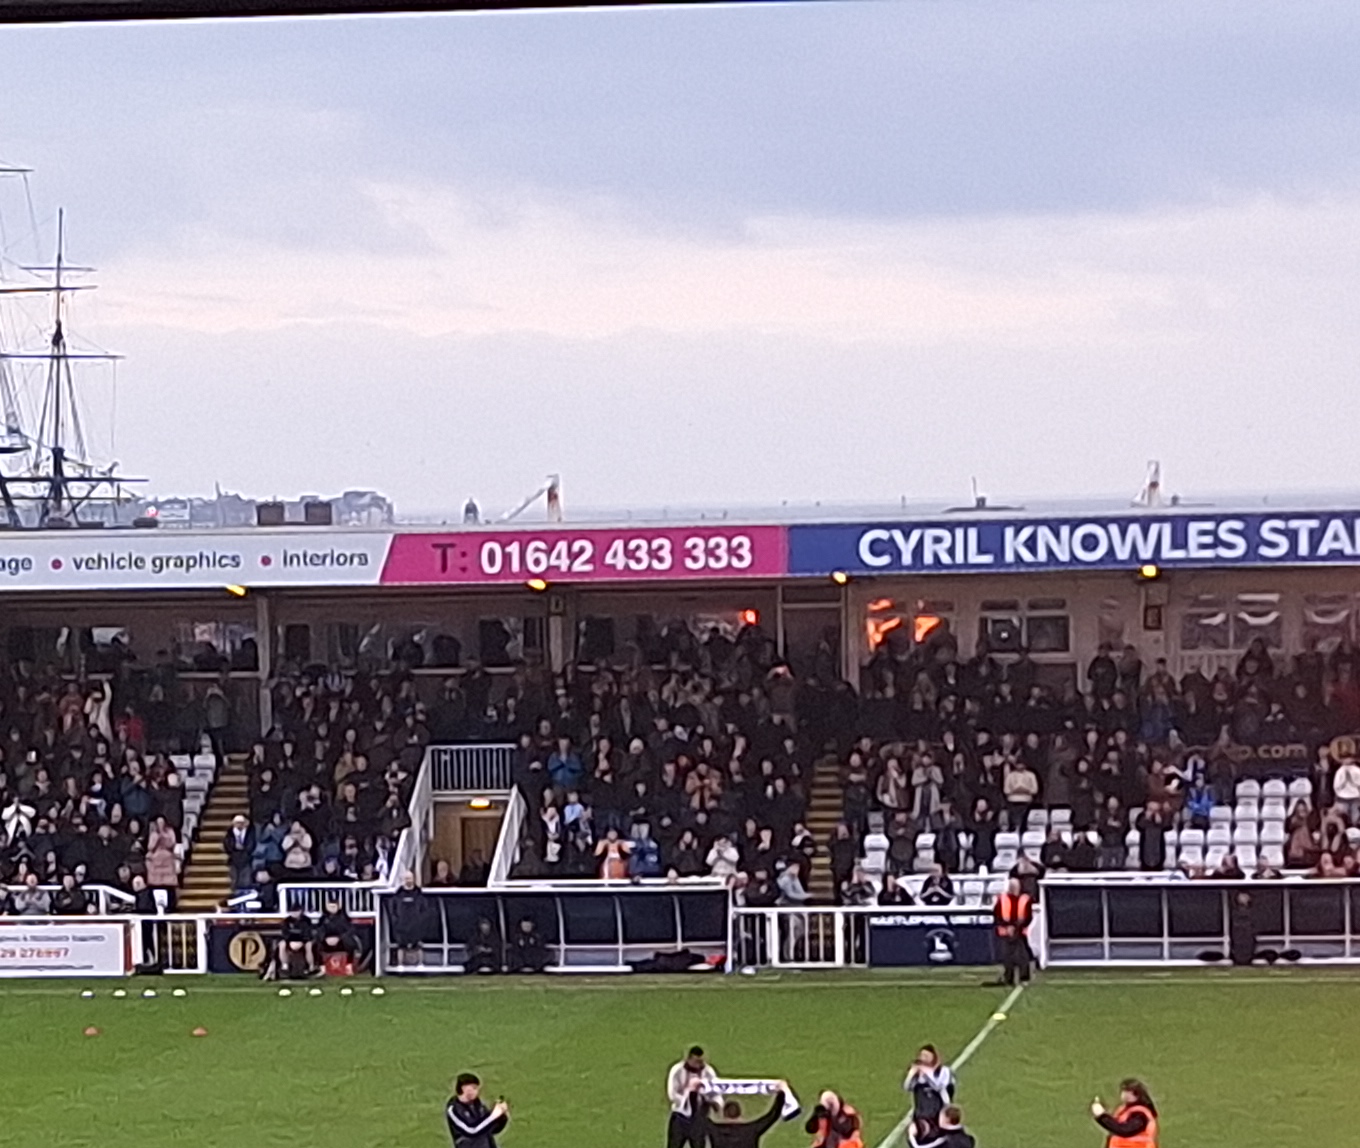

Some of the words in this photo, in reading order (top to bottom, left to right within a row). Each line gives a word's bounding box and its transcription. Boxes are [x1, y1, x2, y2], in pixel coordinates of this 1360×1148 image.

[72, 552, 146, 571] vehicle
[151, 551, 241, 575] graphics
[283, 549, 369, 568] interiors
[432, 543, 468, 574] T:
[479, 539, 594, 575] 01642
[604, 537, 673, 573] 433
[683, 535, 753, 570] 333
[858, 528, 994, 567] CYRIL
[1005, 520, 1245, 563] KNOWLES
